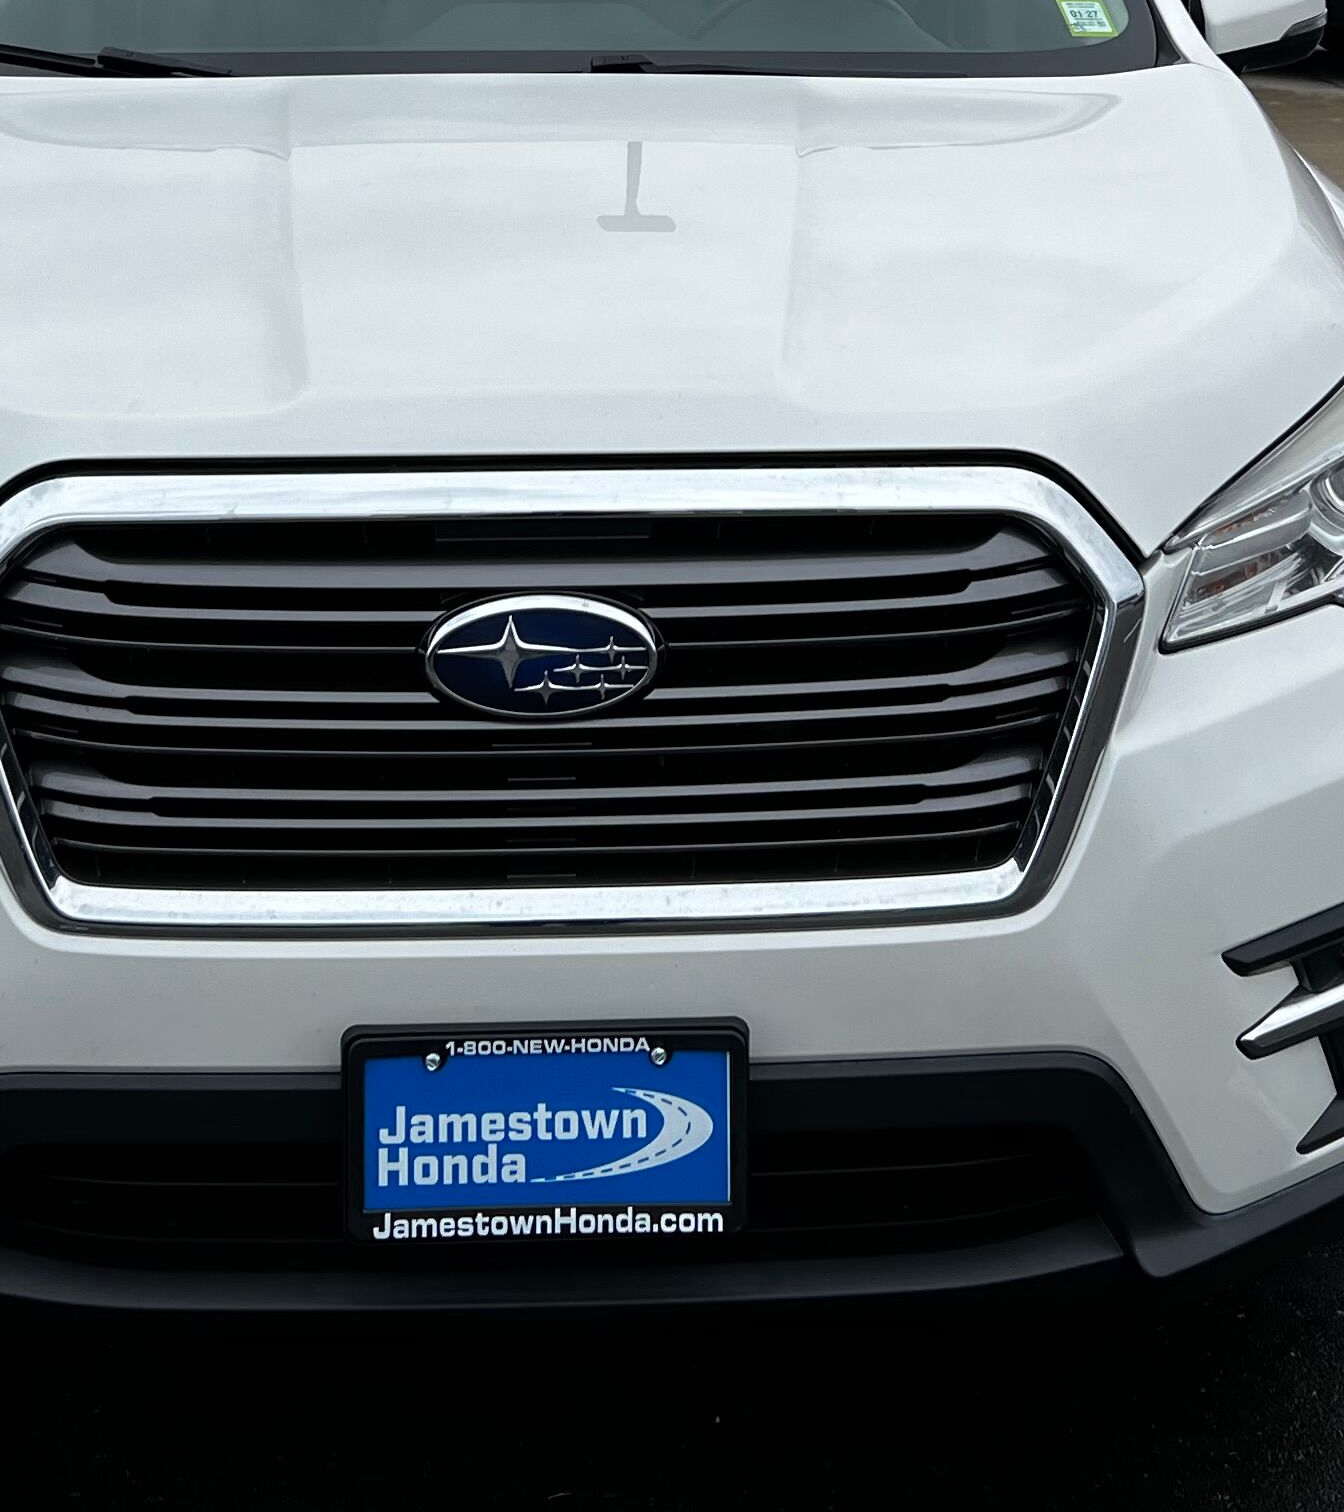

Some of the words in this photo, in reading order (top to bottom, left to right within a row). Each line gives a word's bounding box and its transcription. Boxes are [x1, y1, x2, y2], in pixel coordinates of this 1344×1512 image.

[445, 1037, 650, 1056] 1-800-NEW-HONDA
[379, 1102, 647, 1144] Jamestown
[377, 1143, 526, 1186] Honda
[373, 1206, 724, 1240] JamestownHonda.com
